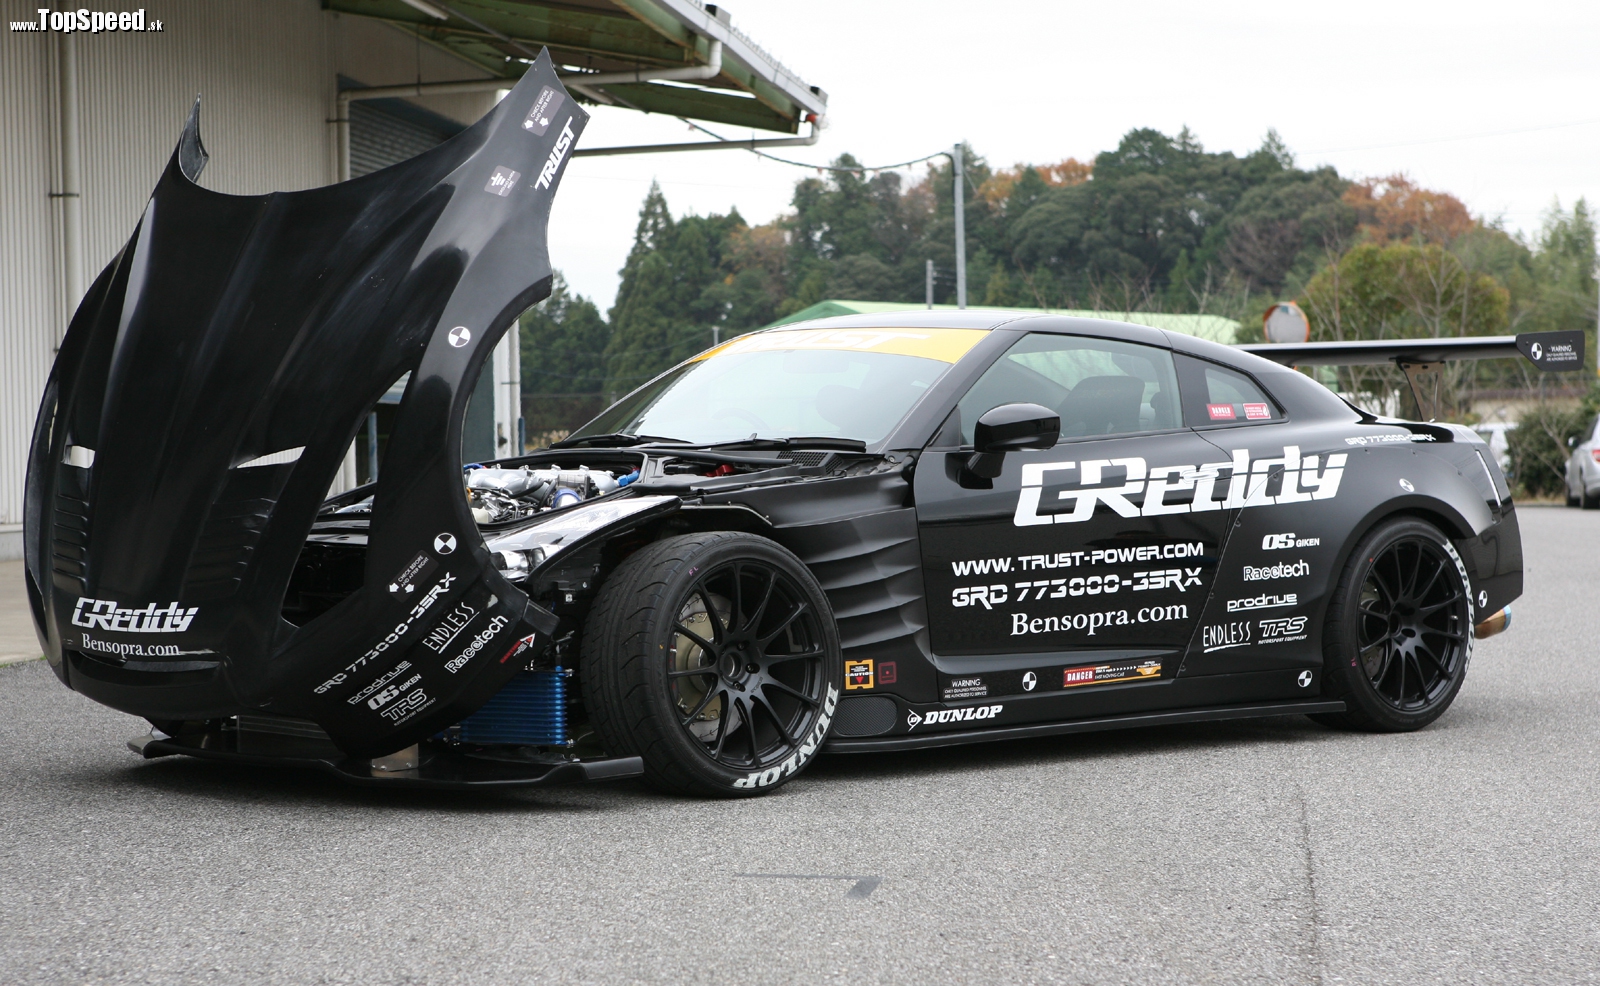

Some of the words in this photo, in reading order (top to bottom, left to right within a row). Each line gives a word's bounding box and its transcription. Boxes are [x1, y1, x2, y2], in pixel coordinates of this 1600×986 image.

[534, 116, 575, 190] TRUST
[1296, 538, 1320, 548] GIKEN
[1243, 559, 1310, 581] Racetech
[422, 602, 475, 651] ENDLESS
[1010, 604, 1189, 636] Bensopra.com
[81, 632, 180, 659] Bensopra.com
[444, 615, 509, 674] Racetech
[1203, 621, 1251, 647] ENDLESS
[399, 673, 422, 692] GIKEN
[952, 678, 981, 688] WARNING
[1067, 671, 1093, 682] DANGER
[923, 704, 1003, 725] DUNLOP
